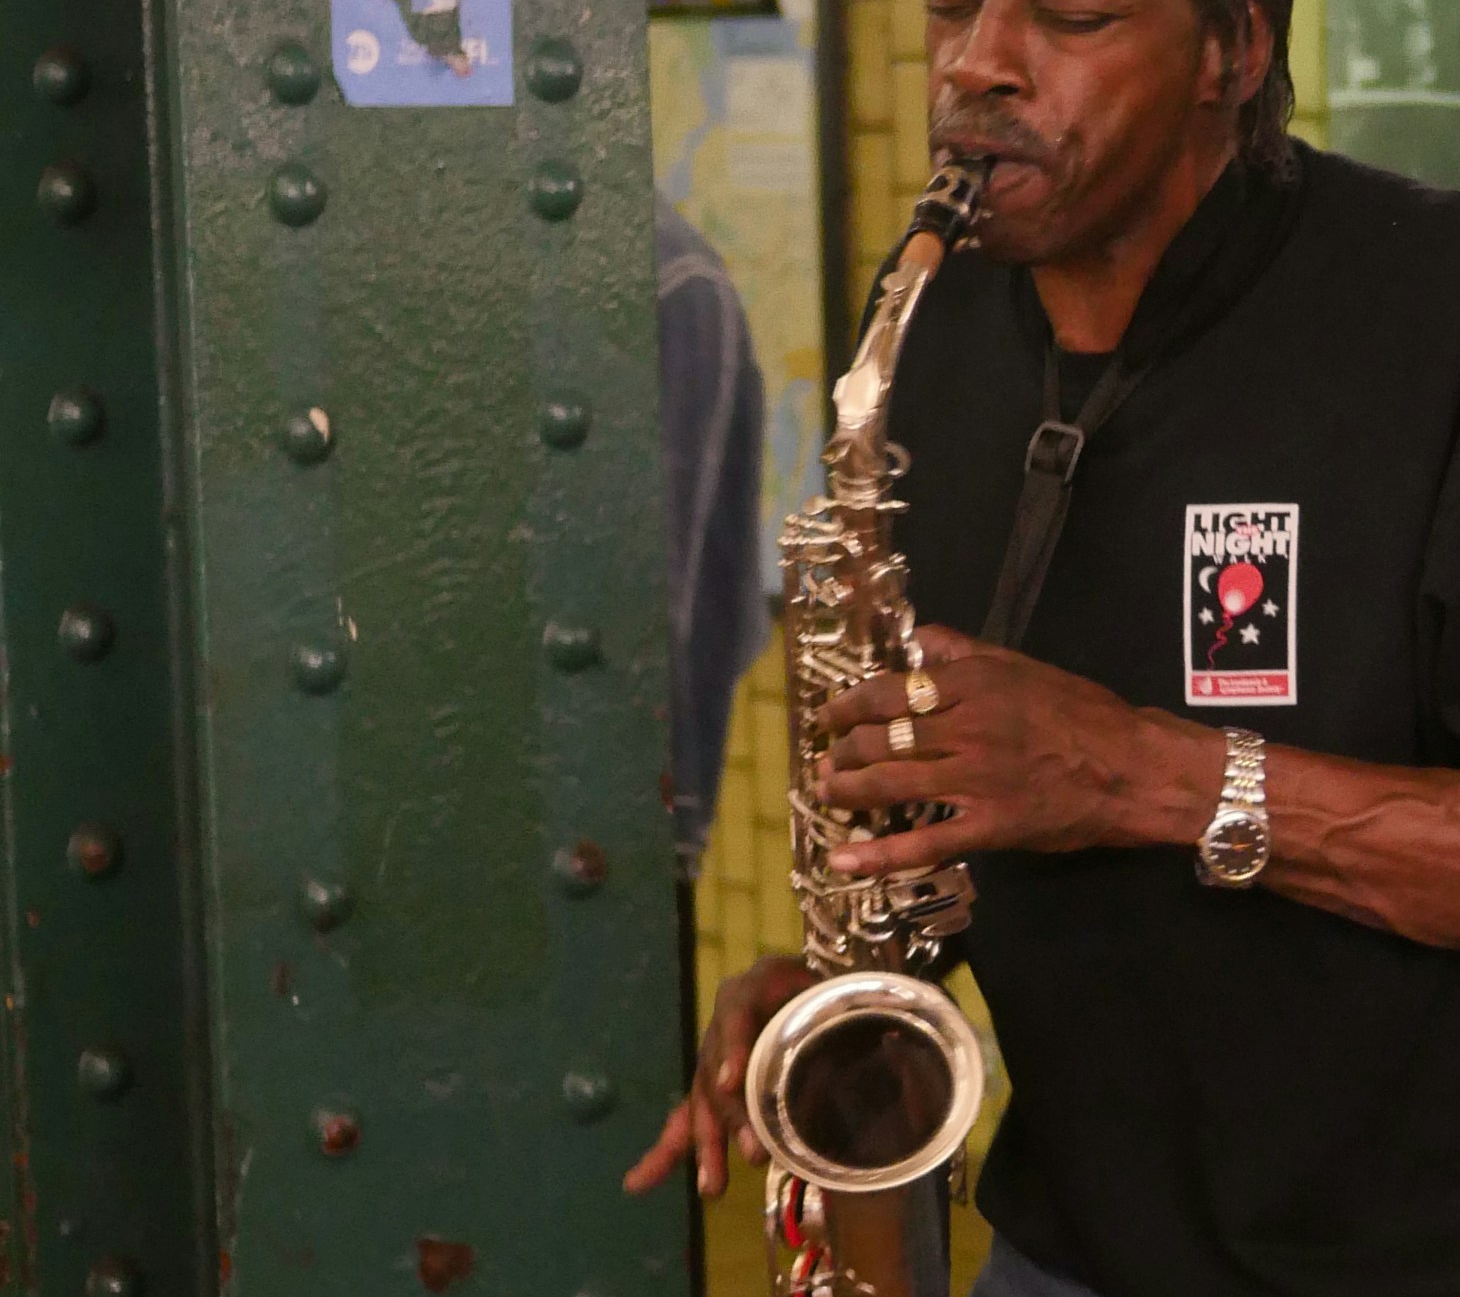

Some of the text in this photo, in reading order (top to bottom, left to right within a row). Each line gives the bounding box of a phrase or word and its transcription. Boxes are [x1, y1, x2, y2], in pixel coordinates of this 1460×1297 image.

[1194, 512, 1290, 533] LIGHT
[1192, 530, 1290, 556] NIGHT
[1213, 553, 1267, 565] WALK
